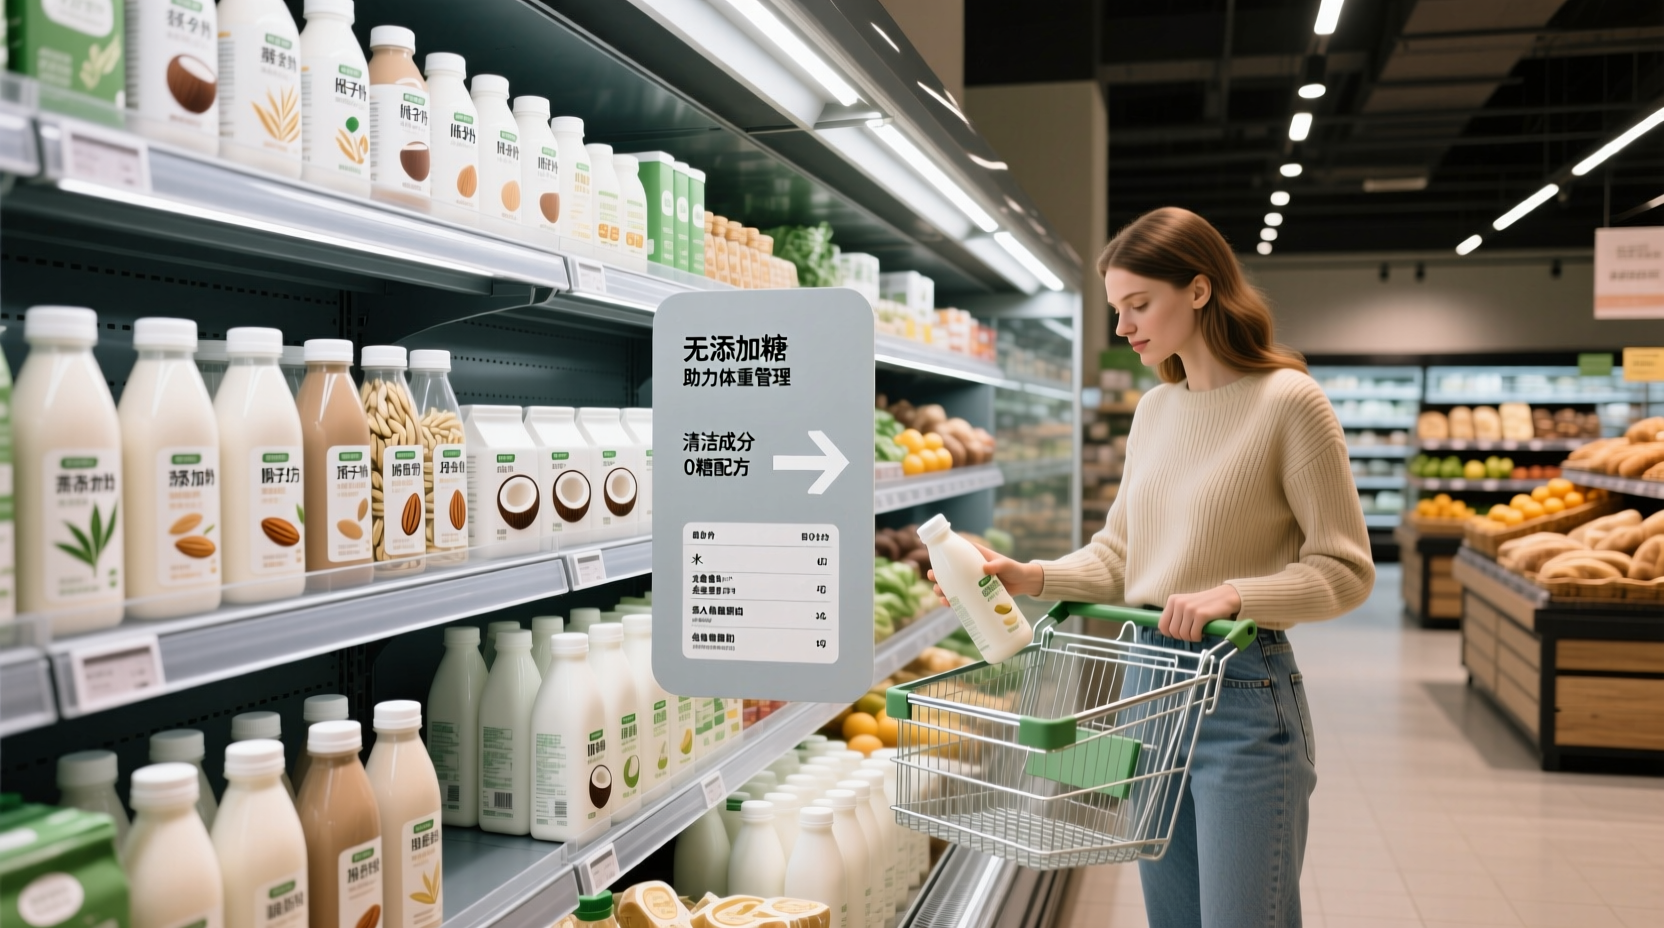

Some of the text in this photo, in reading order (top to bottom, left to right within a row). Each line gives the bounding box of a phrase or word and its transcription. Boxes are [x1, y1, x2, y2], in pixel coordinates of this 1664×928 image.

[684, 334, 788, 362] 无添加糖
[683, 367, 791, 387] 助力体重管理
[683, 431, 755, 452] 清洁成分
[684, 457, 750, 476] 0糖配方
